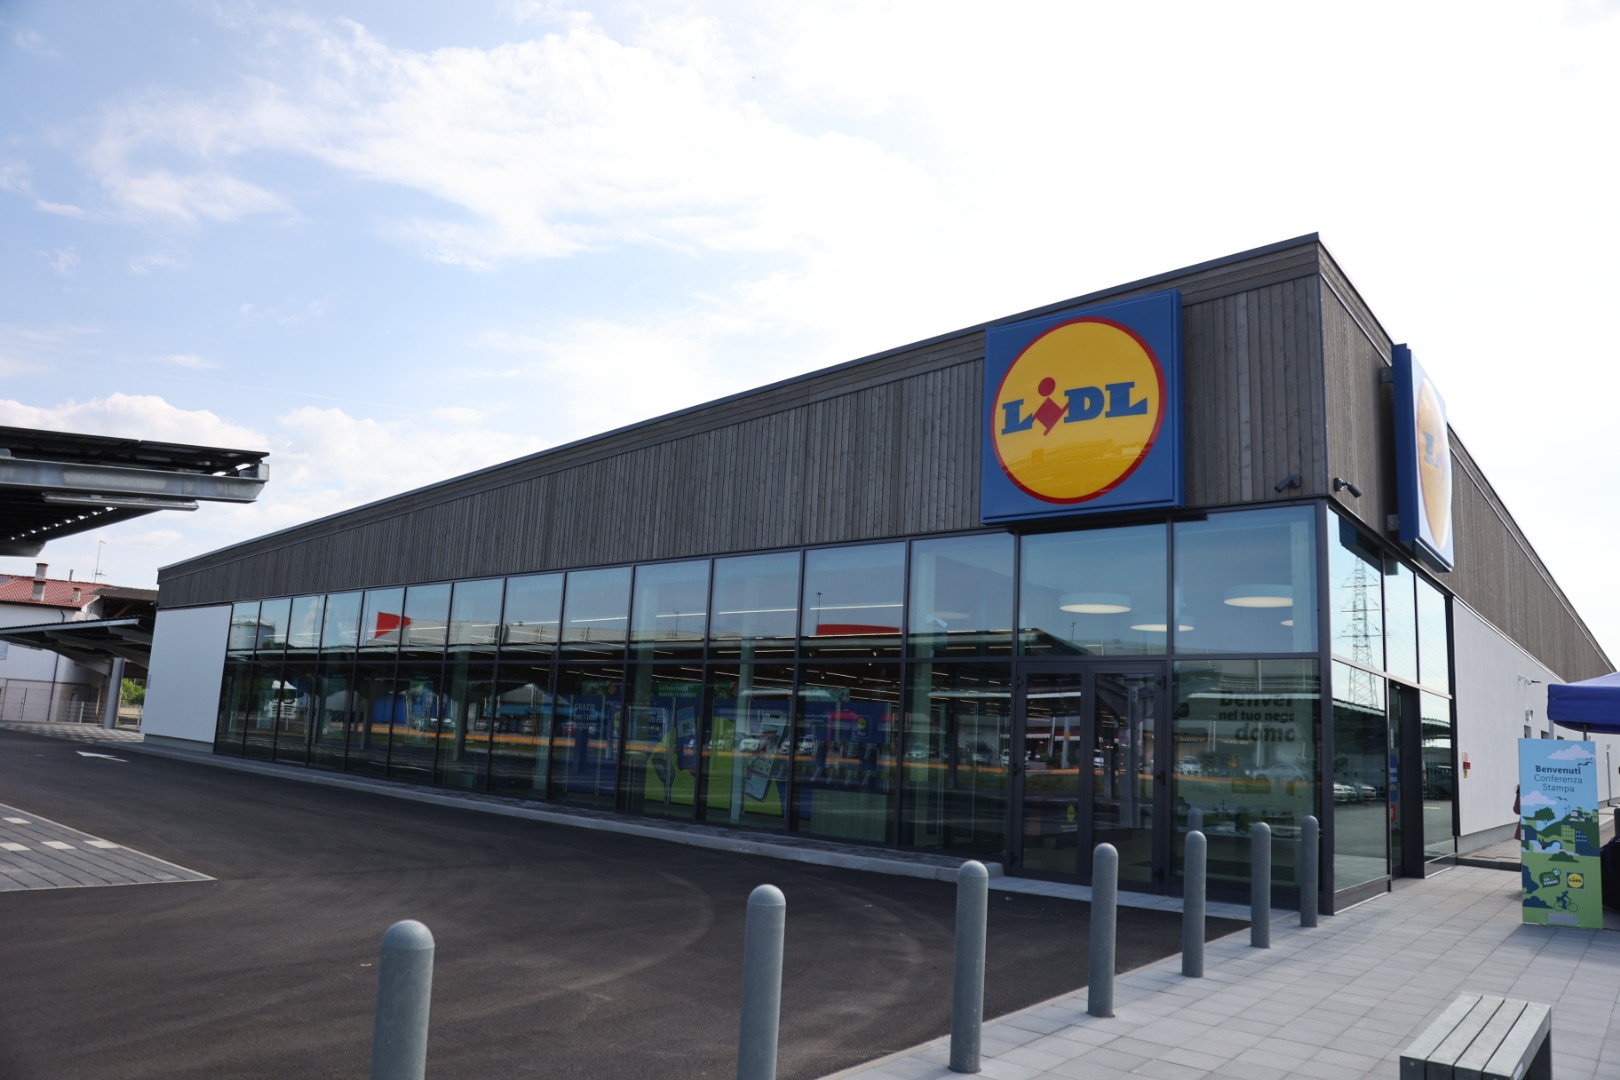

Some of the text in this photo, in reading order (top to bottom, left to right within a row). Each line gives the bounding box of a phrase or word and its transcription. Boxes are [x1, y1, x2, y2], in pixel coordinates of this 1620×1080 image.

[1218, 710, 1238, 721] nel
[1240, 711, 1262, 721] tuo
[1535, 765, 1581, 774] Benvenuti
[1534, 774, 1583, 784] Conferenza
[1542, 783, 1575, 793] Stampa
